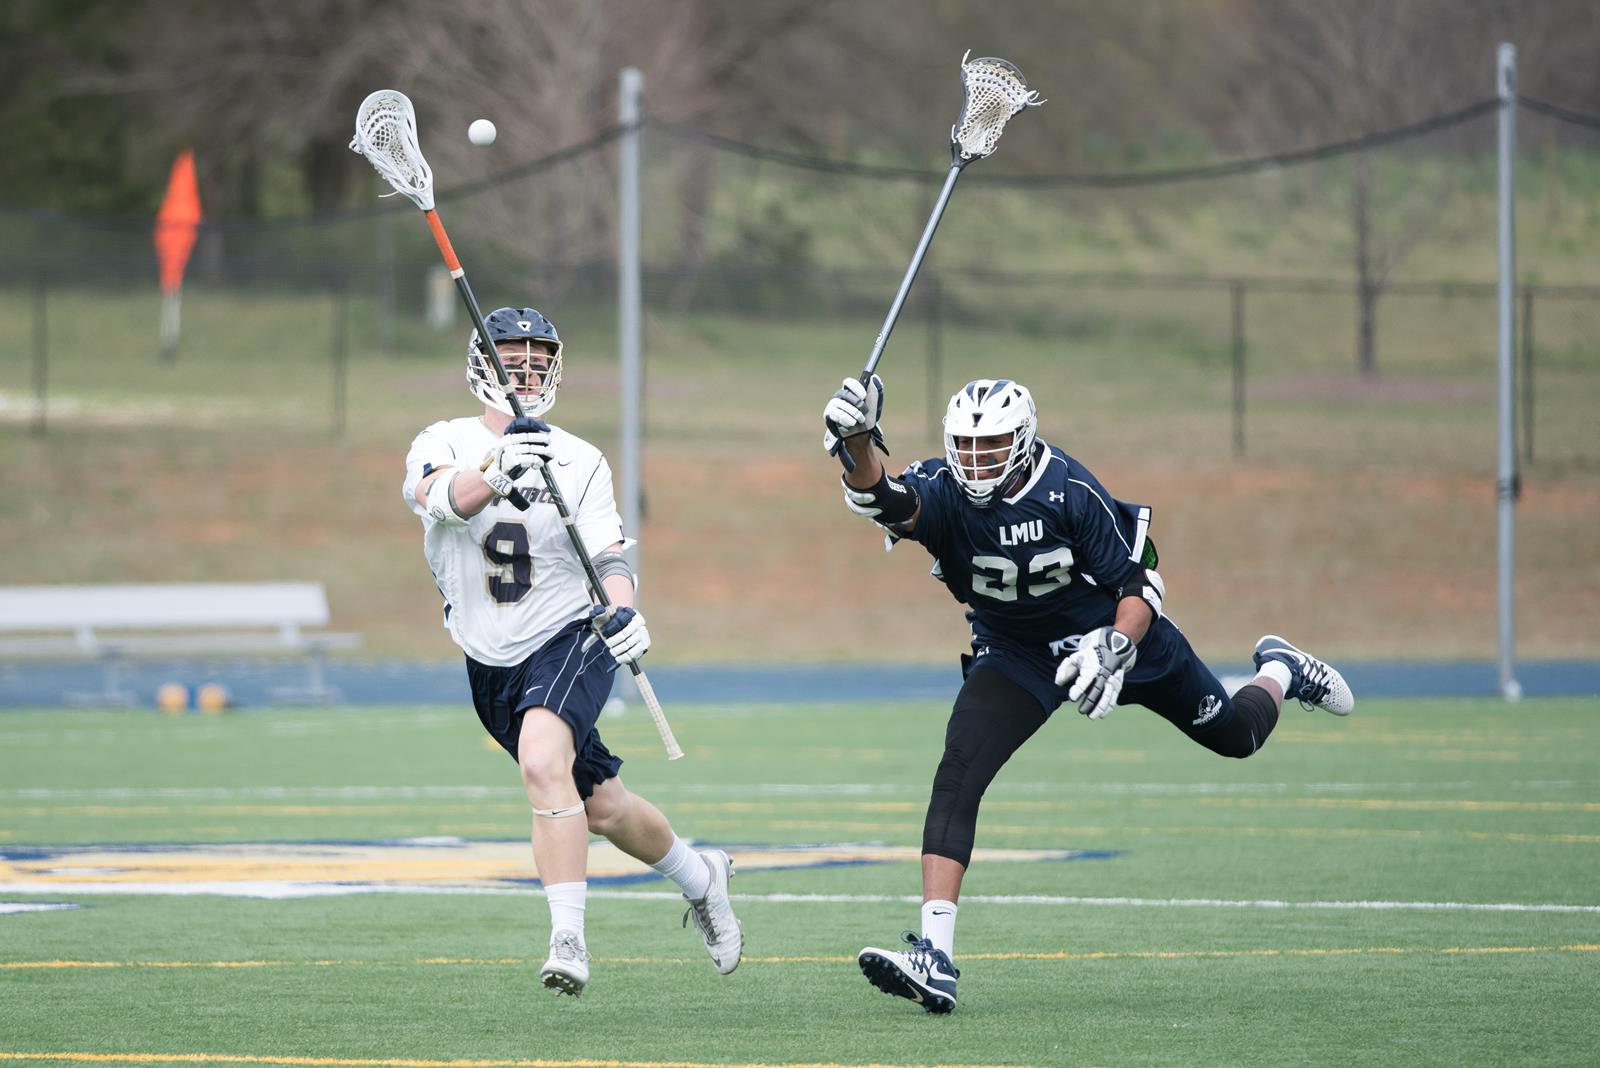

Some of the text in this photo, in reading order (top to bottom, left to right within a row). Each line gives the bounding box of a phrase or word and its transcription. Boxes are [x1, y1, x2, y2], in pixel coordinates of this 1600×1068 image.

[999, 519, 1044, 546] LMU
[481, 517, 535, 608] 9
[971, 546, 1074, 602] 23
